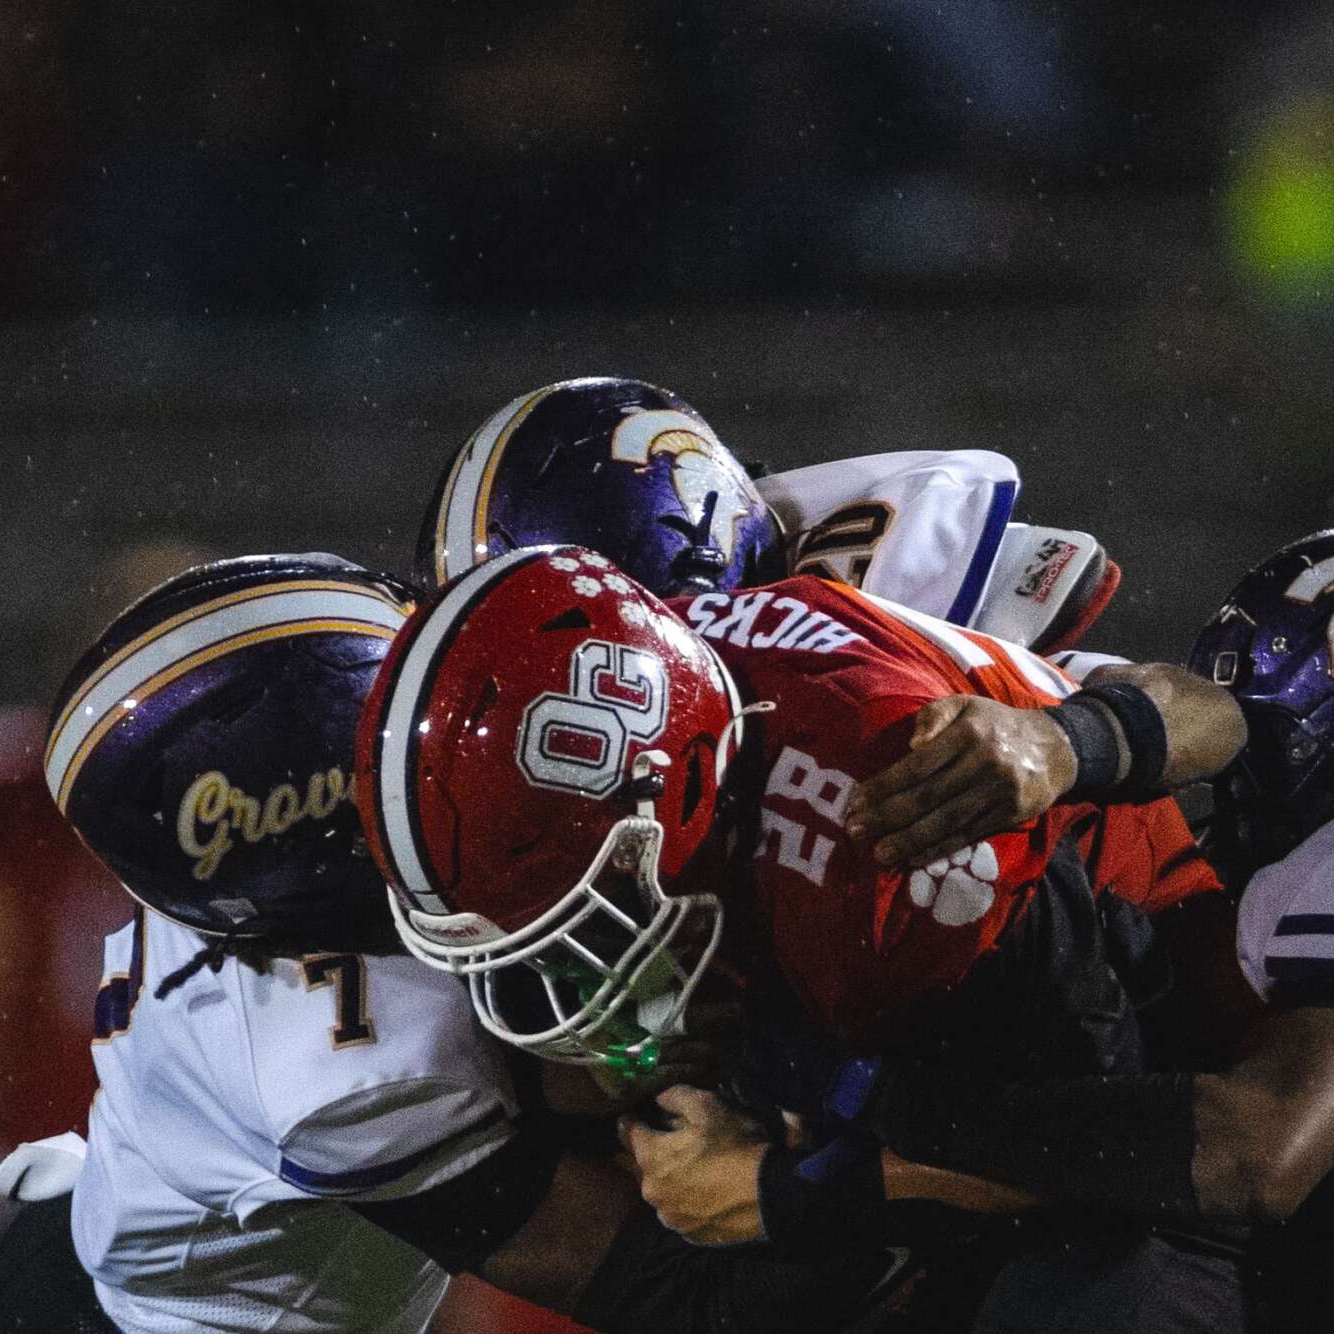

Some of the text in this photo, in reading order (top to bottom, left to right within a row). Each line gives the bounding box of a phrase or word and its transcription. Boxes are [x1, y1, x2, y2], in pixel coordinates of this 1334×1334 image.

[687, 591, 869, 653] HICKS
[516, 638, 670, 800] OC
[177, 767, 357, 880] Grov
[754, 745, 858, 887] 28
